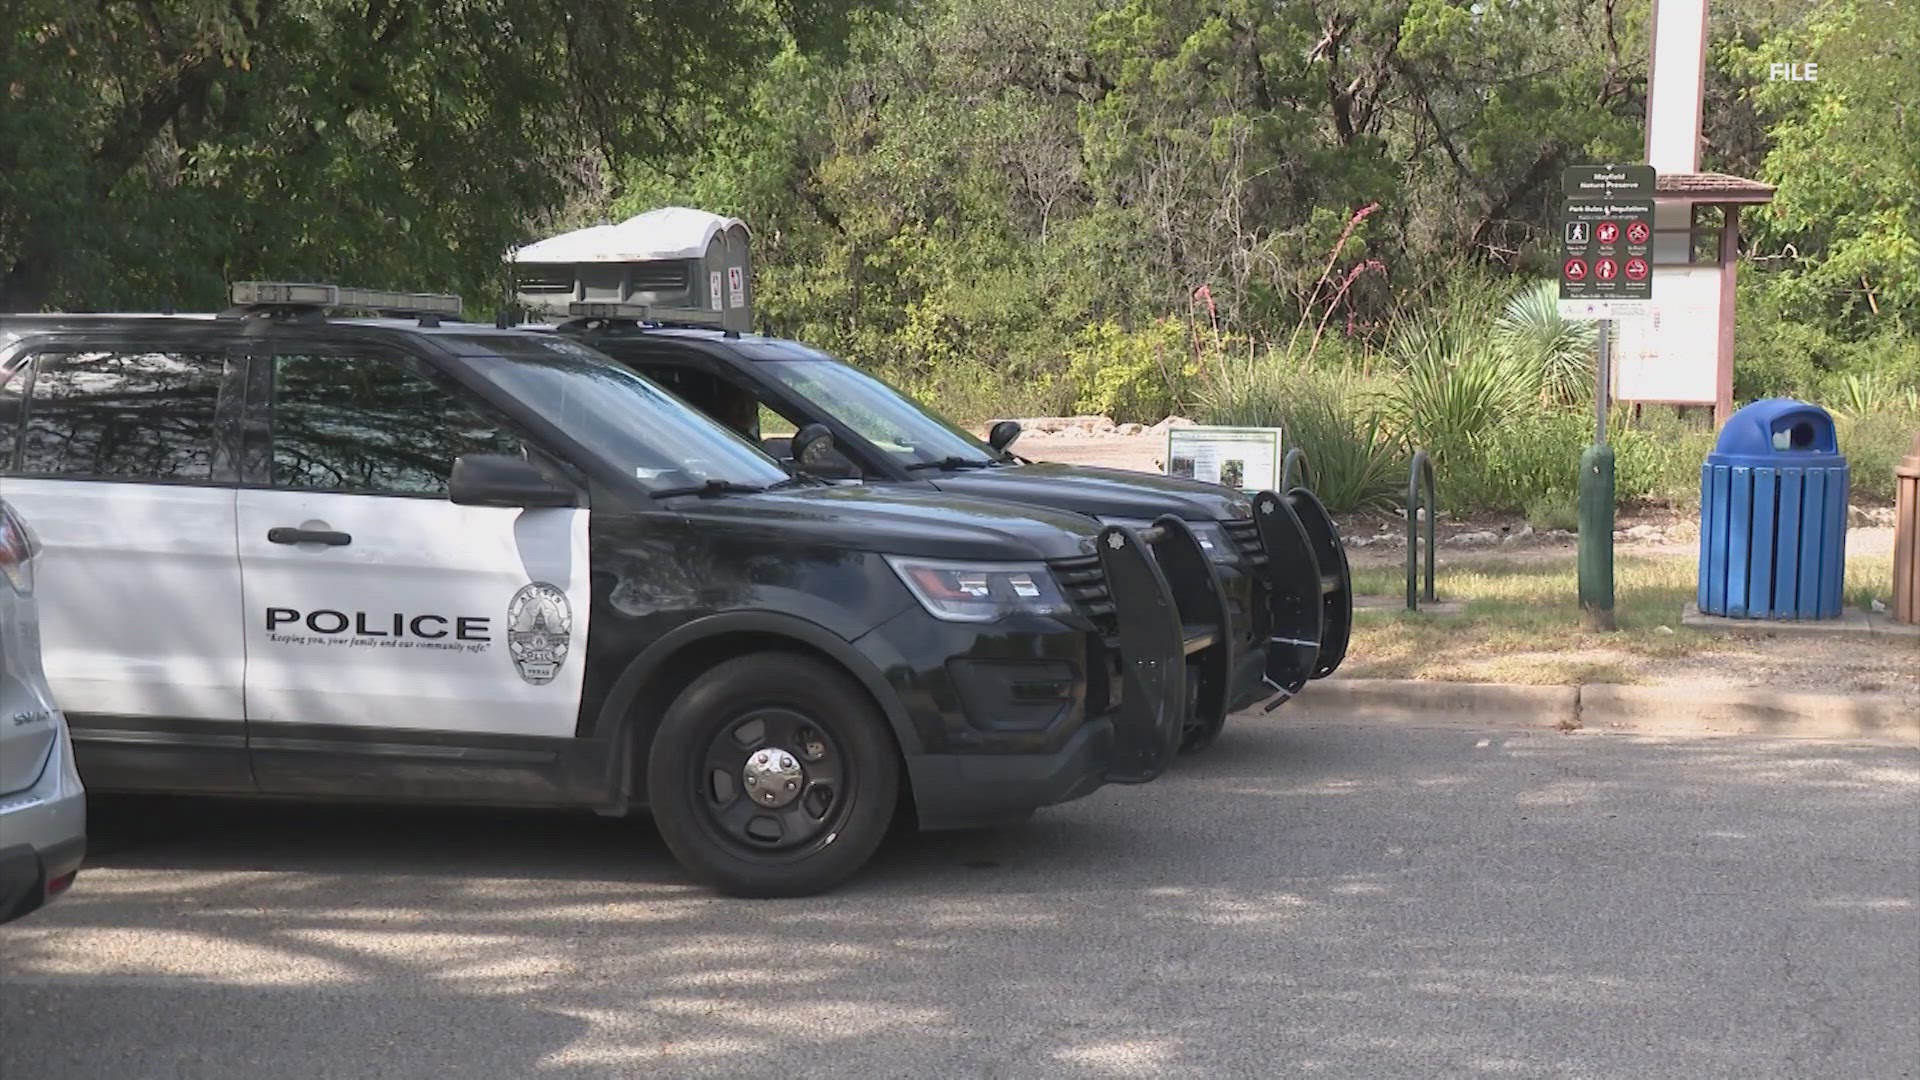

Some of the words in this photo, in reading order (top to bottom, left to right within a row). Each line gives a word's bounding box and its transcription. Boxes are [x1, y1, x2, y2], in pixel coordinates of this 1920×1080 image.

[1594, 173, 1626, 182] Mayfield
[1610, 205, 1649, 213] Regulations
[266, 607, 491, 642] POLICE
[328, 637, 348, 646] your
[348, 637, 377, 648] family
[380, 640, 396, 648] and
[416, 641, 463, 653] community
